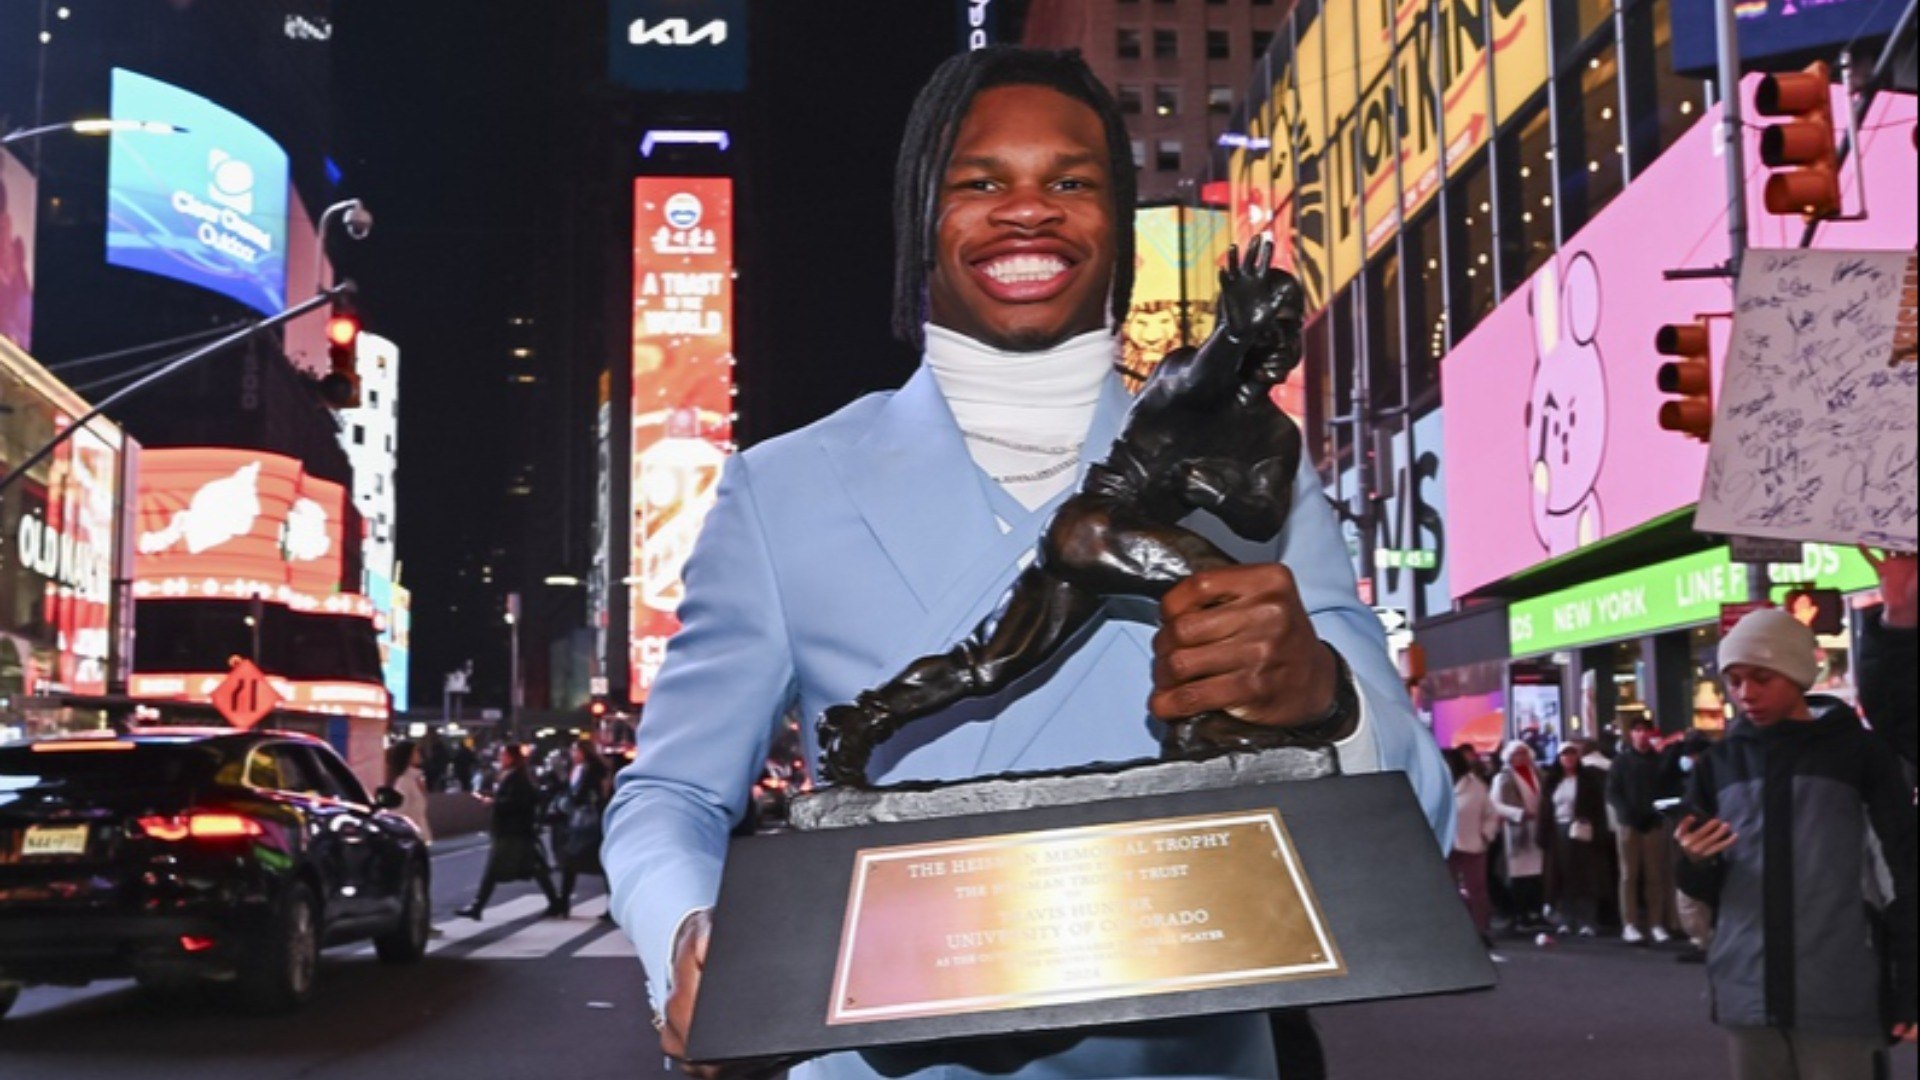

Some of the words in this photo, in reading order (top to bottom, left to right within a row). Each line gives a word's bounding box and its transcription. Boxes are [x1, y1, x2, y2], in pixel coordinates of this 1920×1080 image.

[1334, 62, 1410, 242] LION
[198, 222, 257, 262] Outdoor
[642, 272, 658, 295] A
[643, 311, 722, 335] WORLD
[19, 514, 58, 578] OLD
[1553, 601, 1592, 632] NEW
[1596, 585, 1648, 622] YORK
[1675, 564, 1726, 608] LINE
[1729, 541, 1840, 595] FENDS
[908, 861, 946, 878] THE
[951, 850, 1038, 874] HEISN
[1044, 840, 1149, 862] MEMOAL
[1154, 832, 1230, 853] TROPHY
[955, 884, 987, 899] THE
[992, 876, 1065, 897] HMAN
[1070, 871, 1134, 887] TROPY
[1138, 864, 1189, 881] TRUST
[945, 925, 1062, 949] UNIVSITY
[1068, 920, 1094, 936] OF
[1099, 909, 1209, 933] CORADO
[997, 906, 1066, 923] TAVIS
[1071, 895, 1153, 918] HUNER
